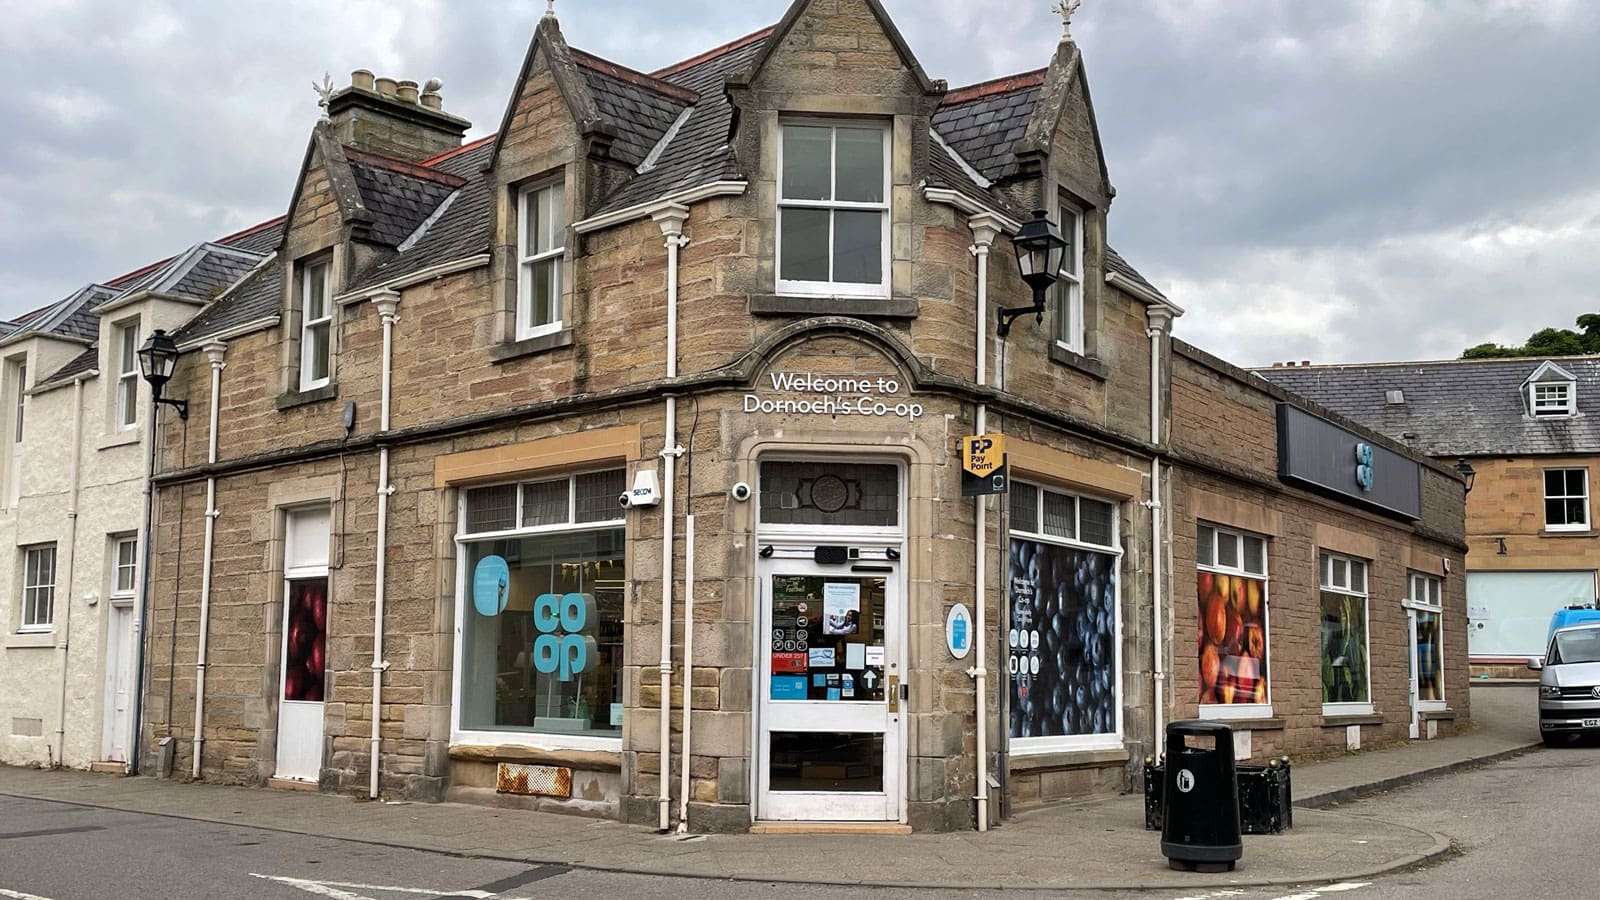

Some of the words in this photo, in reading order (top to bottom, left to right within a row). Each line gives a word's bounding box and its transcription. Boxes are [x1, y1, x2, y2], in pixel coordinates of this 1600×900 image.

[770, 372, 871, 393] Welcome
[877, 376, 899, 394] to
[743, 394, 851, 415] Dornoch's
[857, 396, 923, 422] Co-op
[971, 455, 986, 464] Pay
[971, 462, 993, 470] Point
